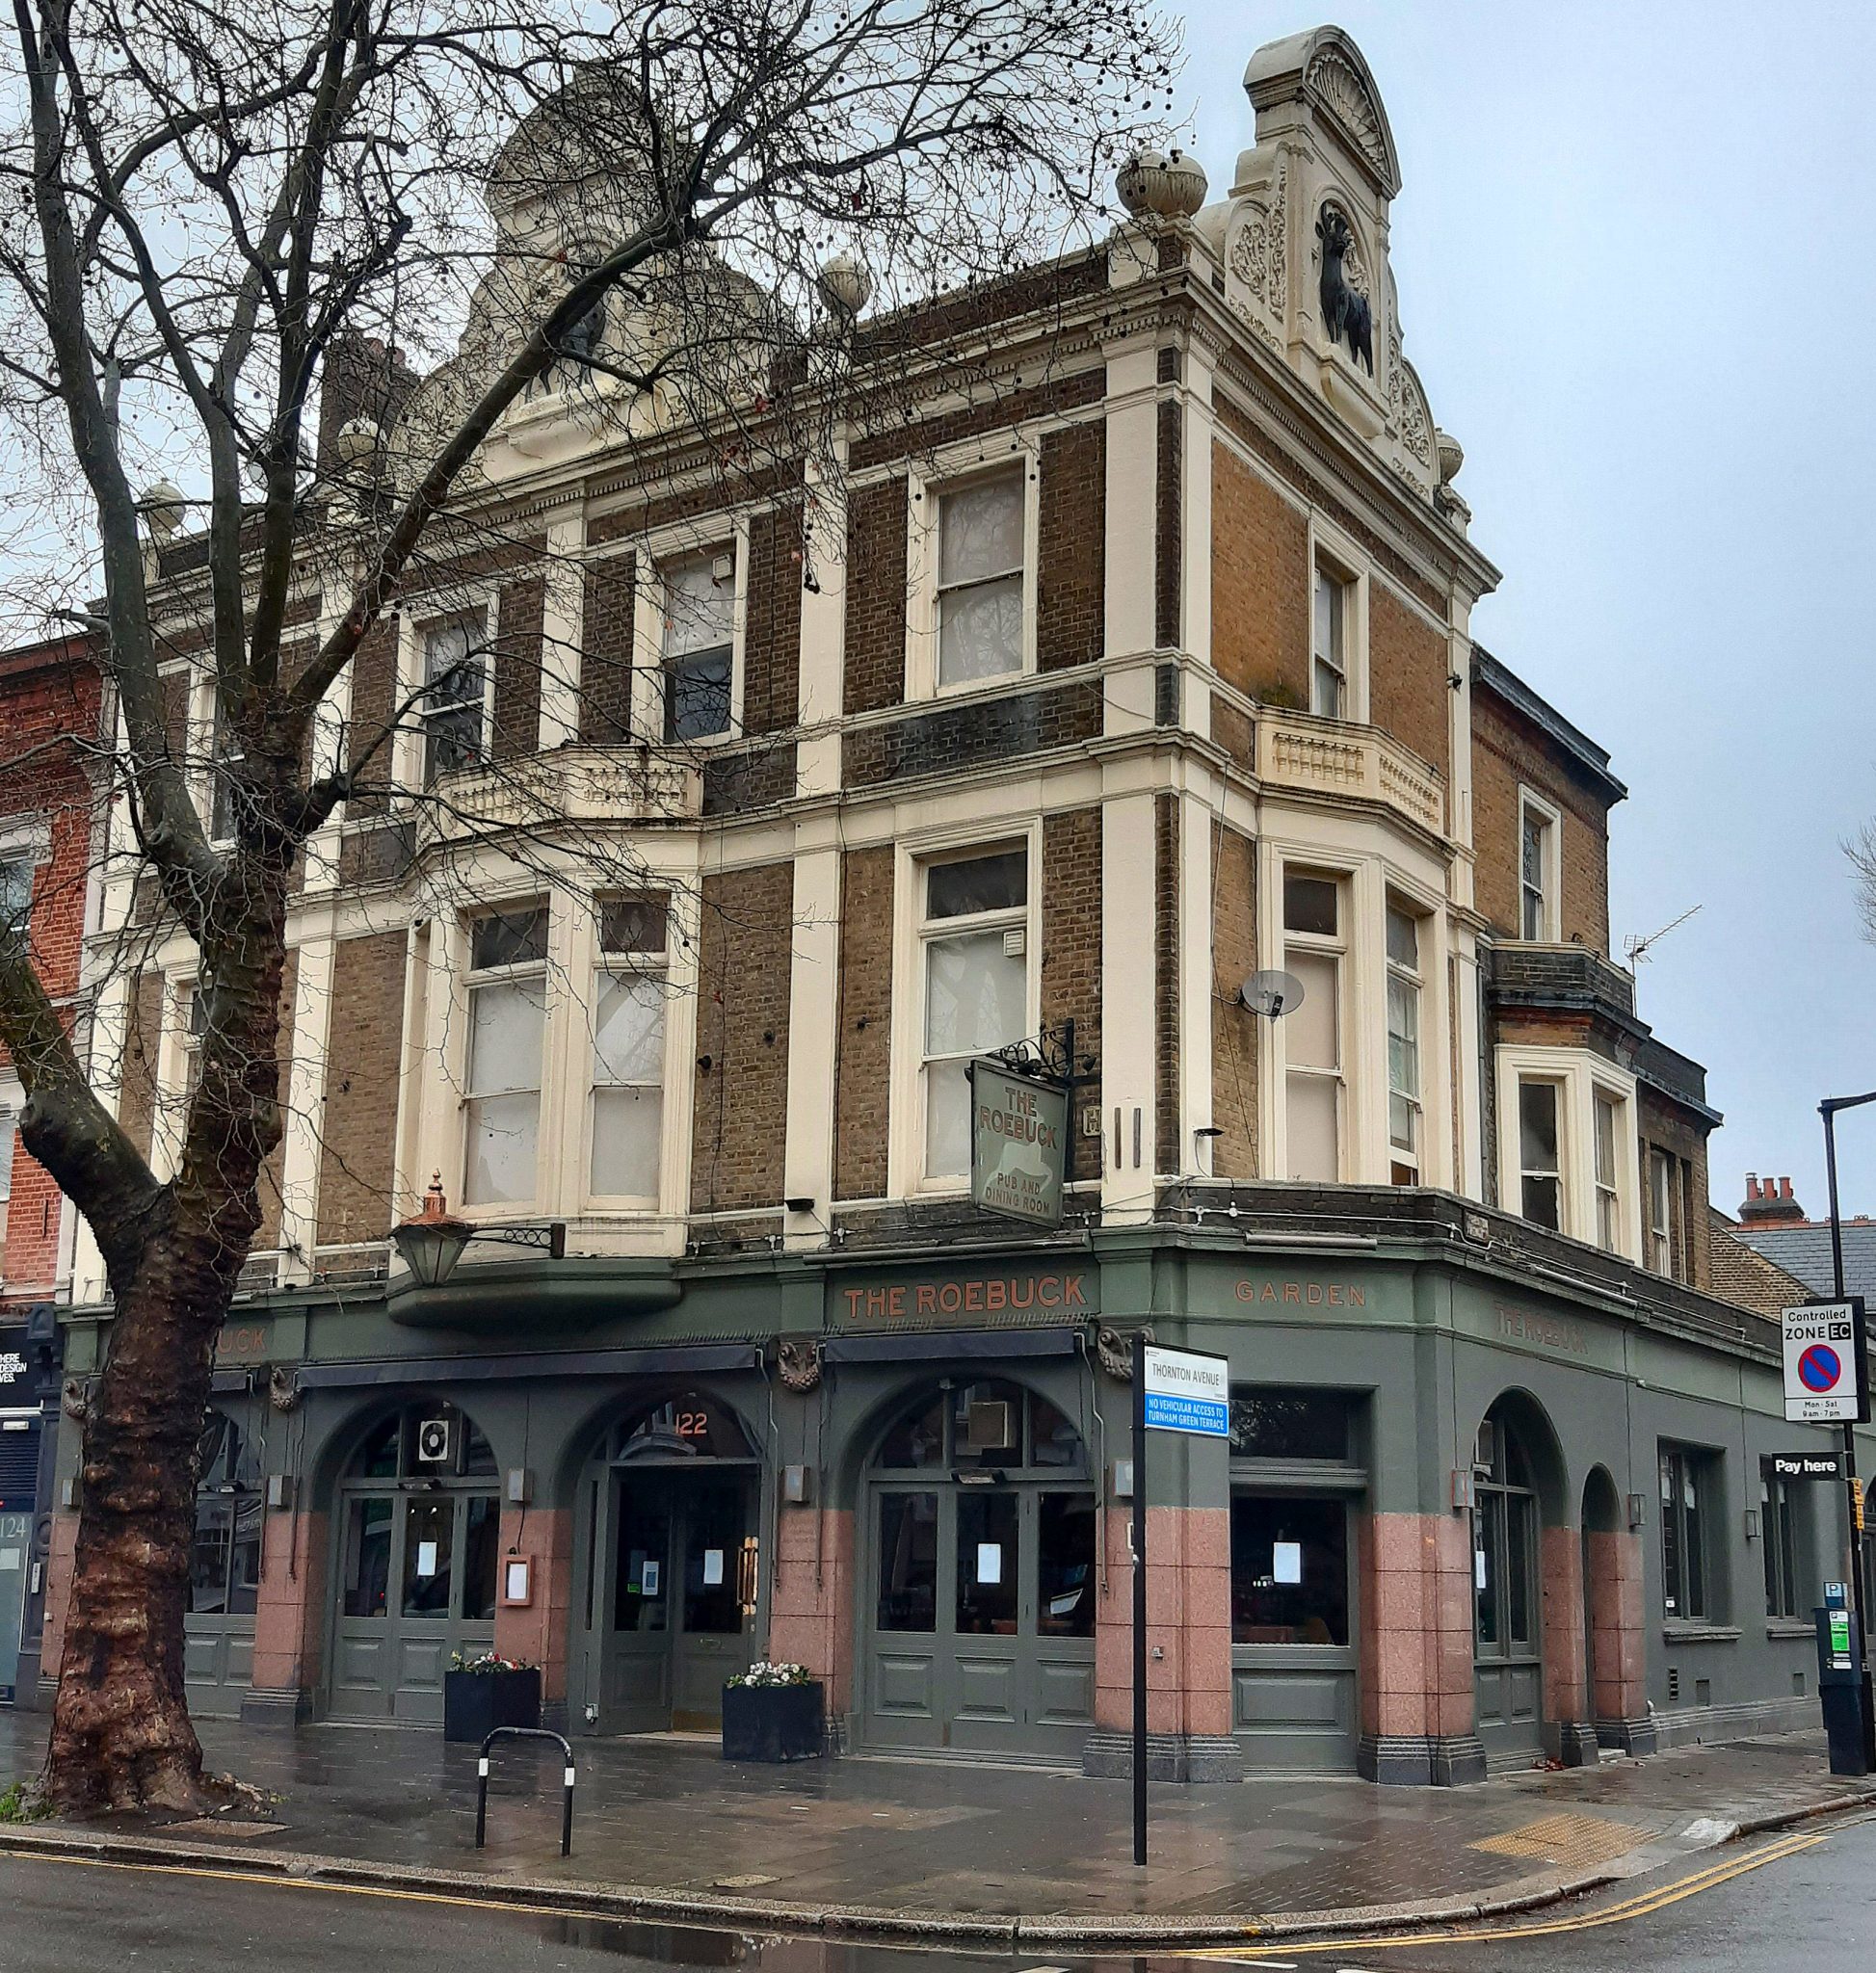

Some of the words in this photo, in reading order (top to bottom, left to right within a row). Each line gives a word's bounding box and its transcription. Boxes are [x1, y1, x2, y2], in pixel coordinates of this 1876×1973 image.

[1005, 1086, 1038, 1118] THE
[980, 1105, 1057, 1150] ROEBUCK
[997, 1172, 1017, 1190] PUB
[1021, 1179, 1041, 1196] AND
[986, 1186, 1019, 1207] DINING
[1023, 1196, 1049, 1214] ROOM
[843, 1286, 907, 1319] THE
[915, 1274, 1088, 1314] ROEBUCK
[1235, 1279, 1366, 1306] GARDEN
[1493, 1302, 1523, 1337] THE
[1788, 1309, 1847, 1323] Controlled
[1785, 1327, 1826, 1340] ZONE
[1830, 1324, 1850, 1338] EC
[0, 1362, 27, 1373] DESIGN
[1151, 1363, 1191, 1381] THORNTON
[1193, 1370, 1220, 1386] AVENUE
[1149, 1398, 1158, 1407] NO
[1159, 1400, 1192, 1414] VEHICULAR
[1193, 1405, 1214, 1417] ACCESS
[1216, 1408, 1224, 1417] TO
[675, 1412, 707, 1434] 122
[1149, 1410, 1177, 1424] TURNHAM
[1178, 1414, 1199, 1426] GREEN
[1200, 1418, 1225, 1430] TERRACE
[1775, 1460, 1801, 1474] Pay
[1804, 1459, 1836, 1472] here
[0, 1516, 26, 1539] 124
[1829, 1584, 1838, 1595] P
